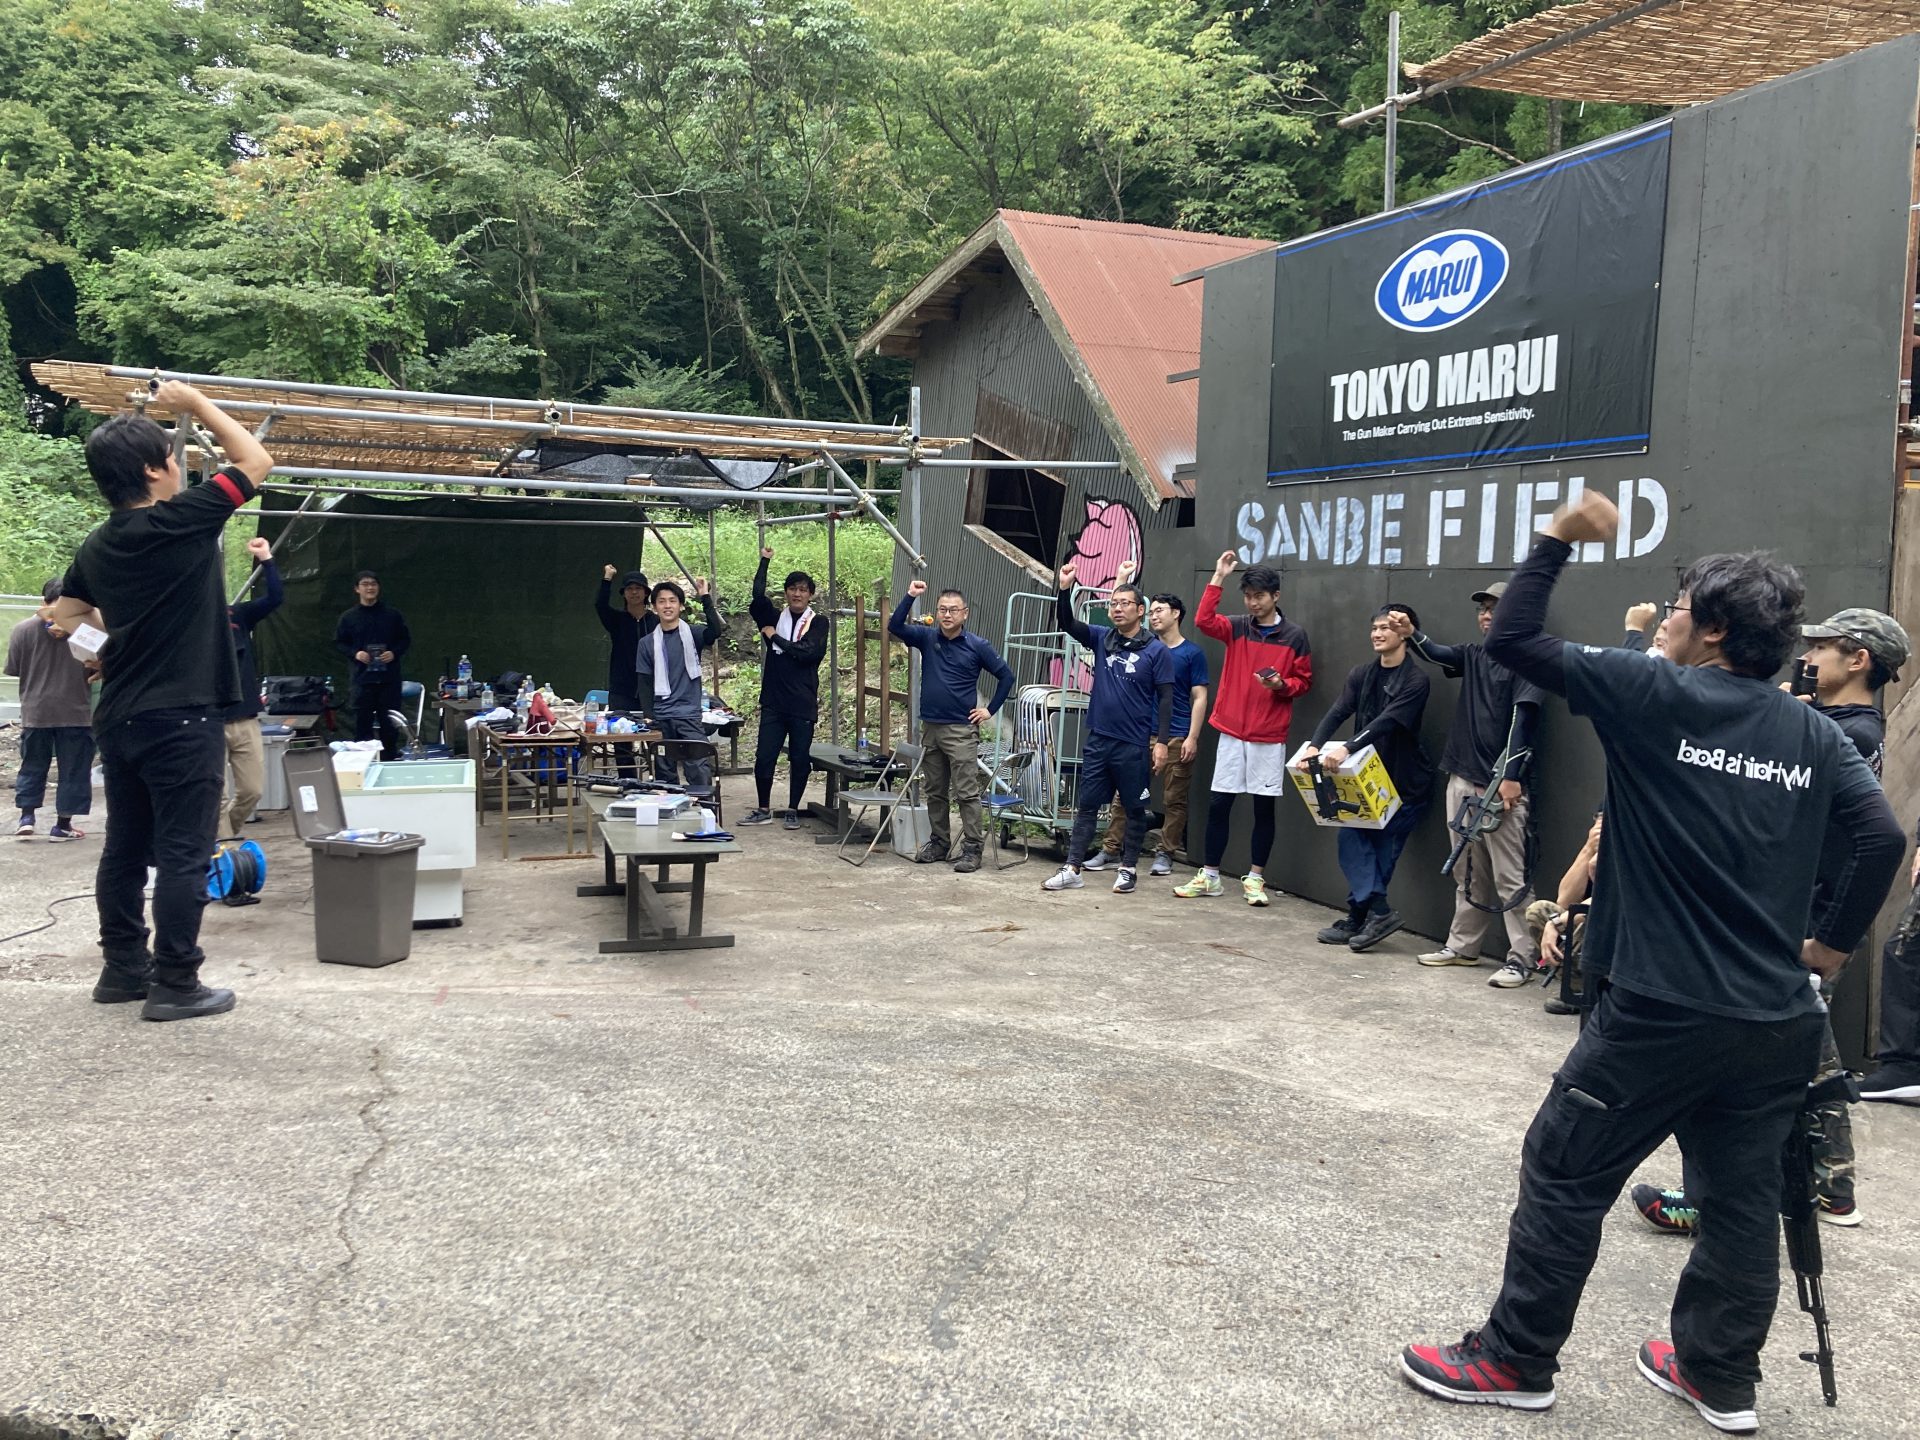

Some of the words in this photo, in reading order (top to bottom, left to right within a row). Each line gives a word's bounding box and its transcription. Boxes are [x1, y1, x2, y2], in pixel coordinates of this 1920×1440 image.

[1401, 254, 1478, 307] MARUI
[1330, 358, 1430, 423] TOKYO
[1436, 334, 1559, 408] MARUI
[1342, 430, 1356, 442] The
[1357, 428, 1372, 440] Gun
[1372, 425, 1397, 438] Maker
[1397, 421, 1431, 434] Carrying
[1431, 418, 1447, 430] Out
[1447, 414, 1483, 429] Extreme
[1483, 407, 1535, 424] Sensitivity.
[1236, 493, 1404, 566] SANBE
